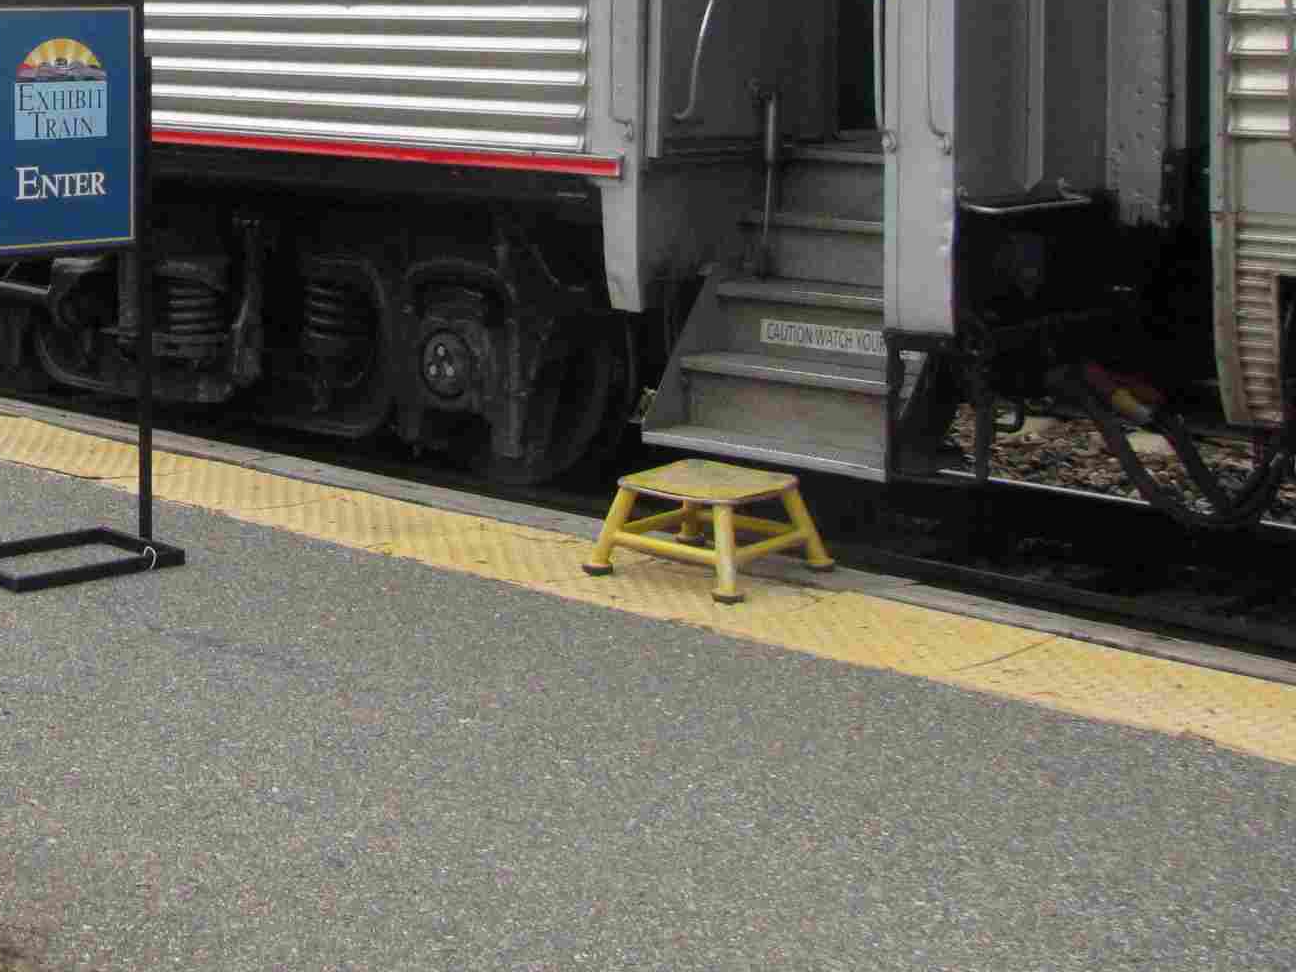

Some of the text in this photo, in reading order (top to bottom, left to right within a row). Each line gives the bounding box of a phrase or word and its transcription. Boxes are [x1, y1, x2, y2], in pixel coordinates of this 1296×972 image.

[18, 83, 105, 111] EXHIBIT
[27, 111, 96, 139] TRAIN
[15, 165, 106, 201] ENTER
[767, 322, 816, 345] CAUTION
[816, 326, 853, 349] WATCH
